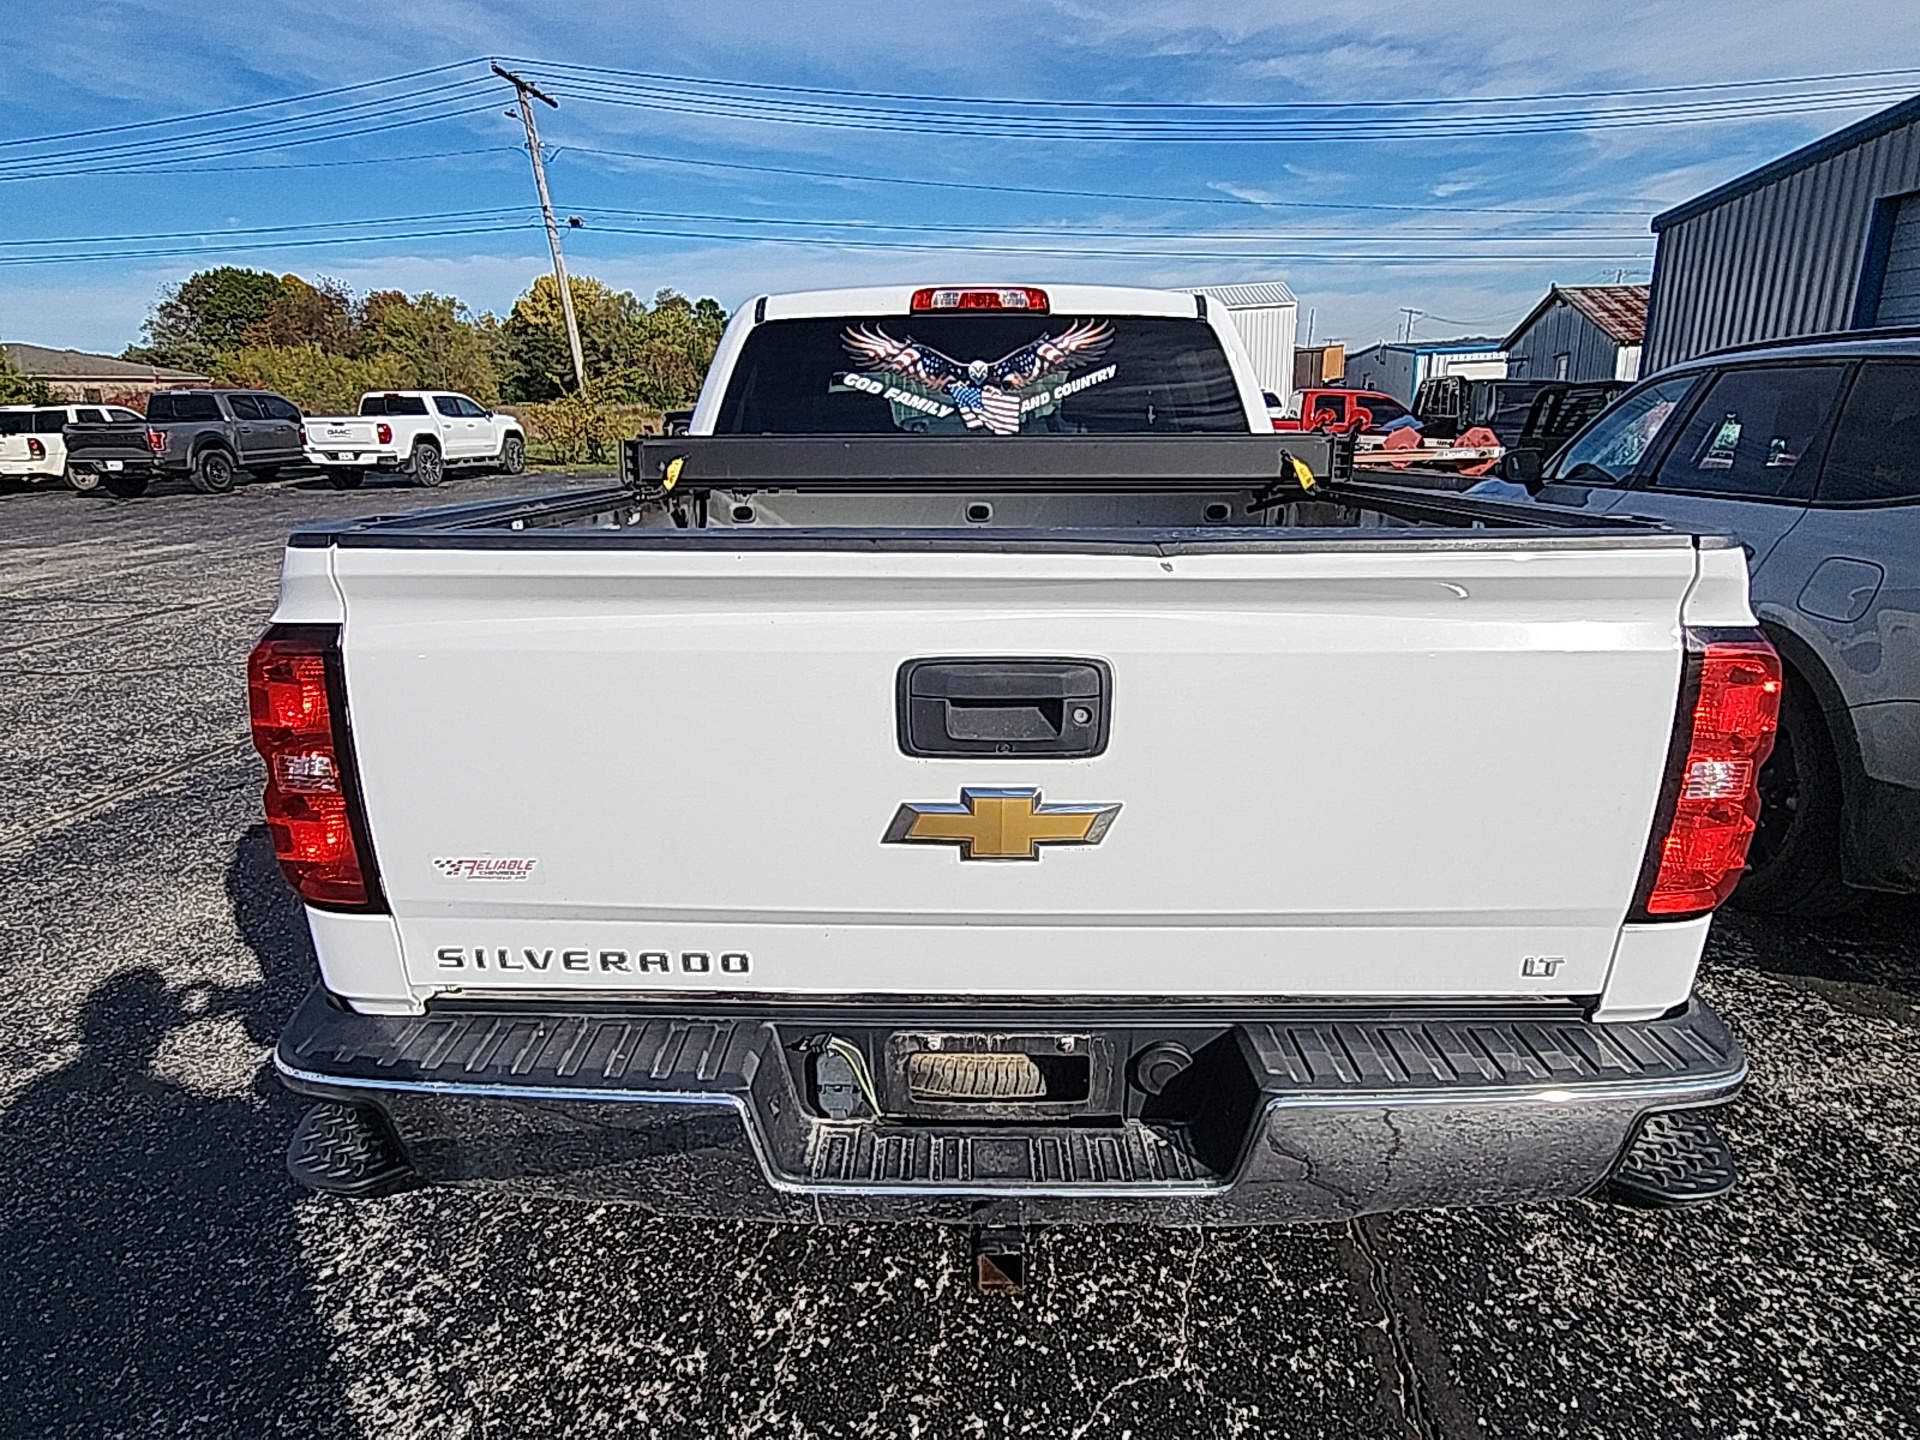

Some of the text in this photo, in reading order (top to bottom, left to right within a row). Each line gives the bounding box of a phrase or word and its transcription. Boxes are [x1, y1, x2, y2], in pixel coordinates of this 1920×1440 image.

[843, 364, 1117, 418] GOD FAMILY AND COUNTRY
[455, 860, 537, 876] RELIABLE
[437, 946, 752, 974] SILVERADO
[1521, 957, 1565, 977] LT
